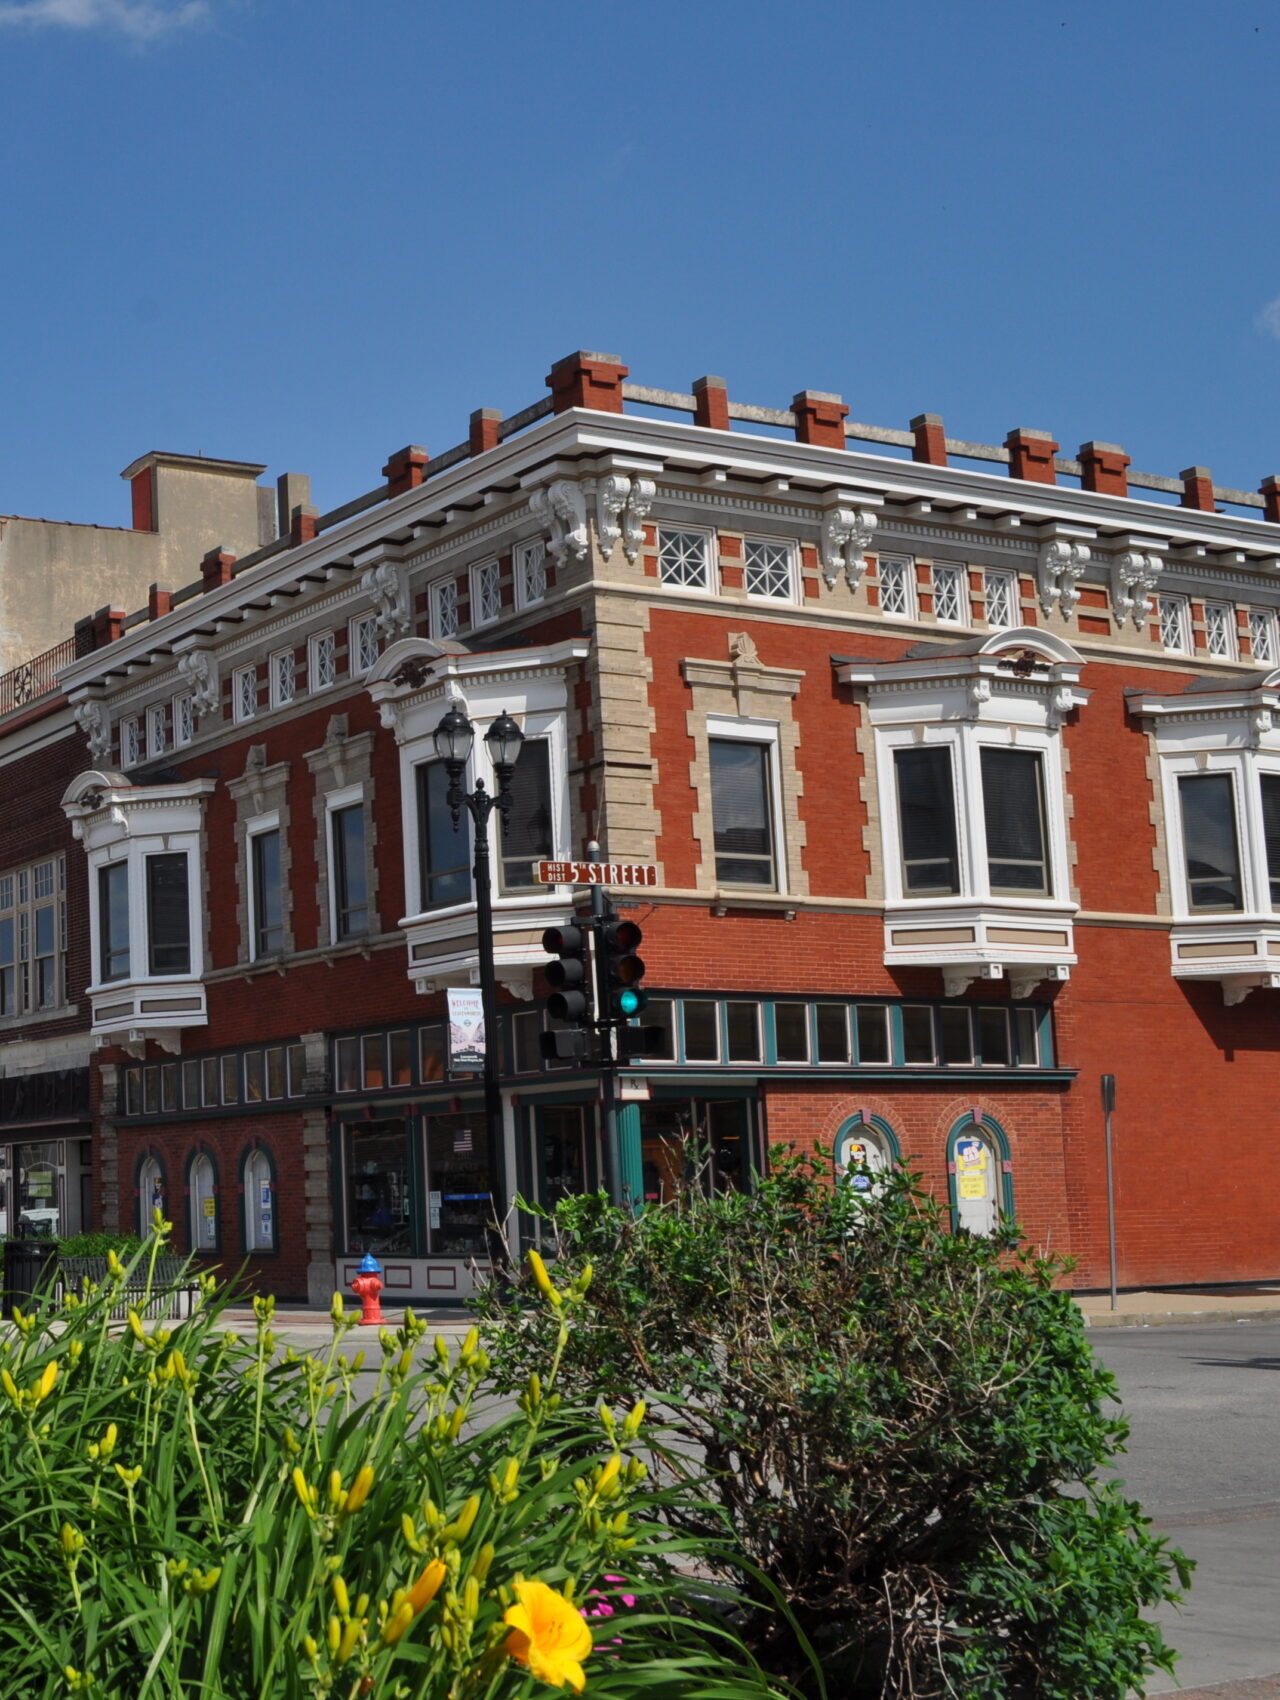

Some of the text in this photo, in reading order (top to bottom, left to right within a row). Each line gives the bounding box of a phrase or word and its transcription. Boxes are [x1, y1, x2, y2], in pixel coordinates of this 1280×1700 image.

[547, 863, 565, 872] HIST
[548, 872, 566, 882] DIST
[588, 863, 650, 885] STREET
